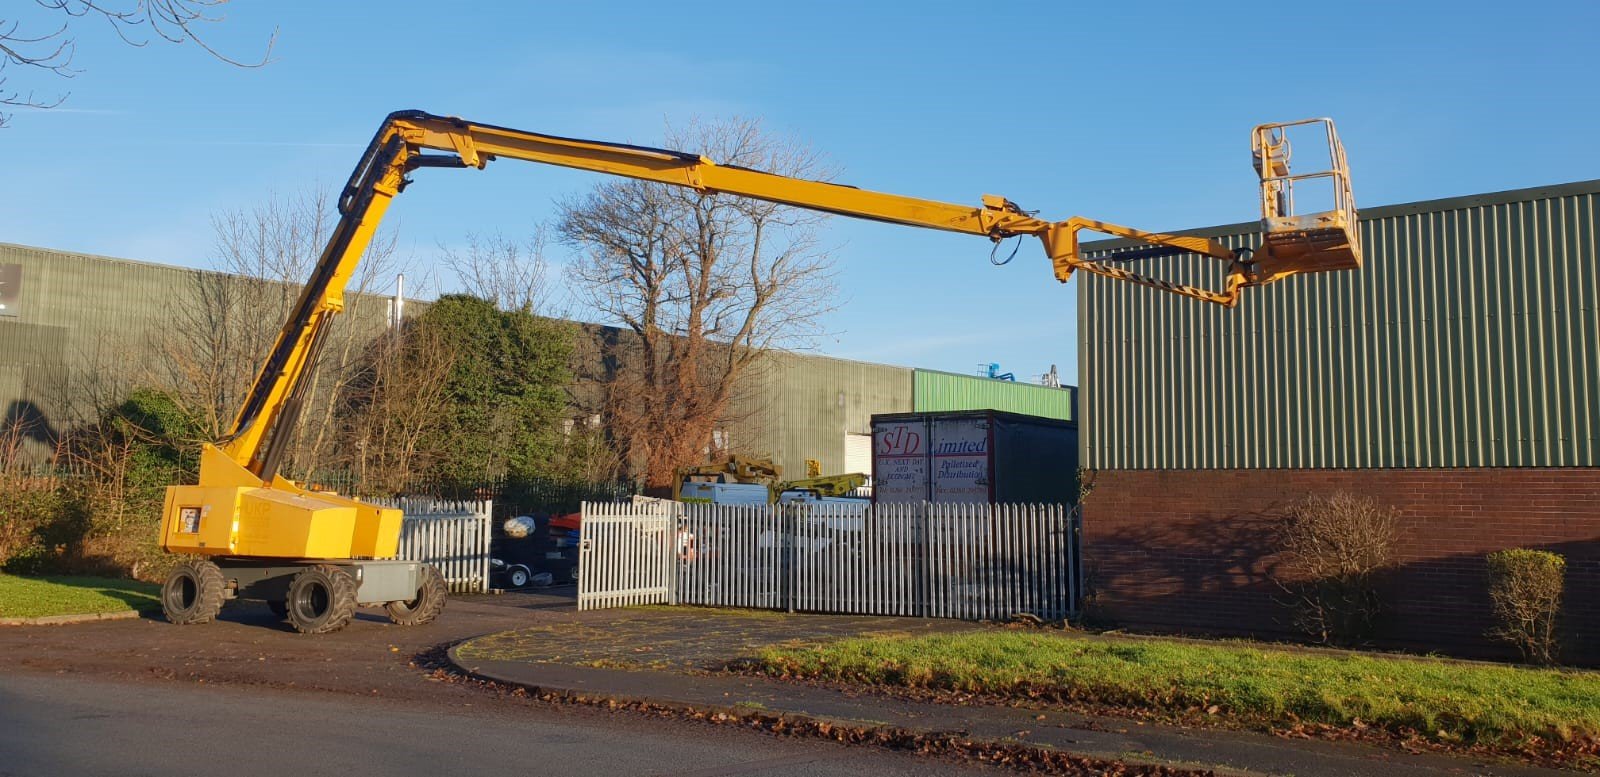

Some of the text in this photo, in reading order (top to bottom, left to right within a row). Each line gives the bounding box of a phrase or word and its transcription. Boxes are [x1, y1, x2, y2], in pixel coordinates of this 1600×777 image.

[881, 426, 987, 454] STD Limited
[938, 470, 983, 479] Distribution
